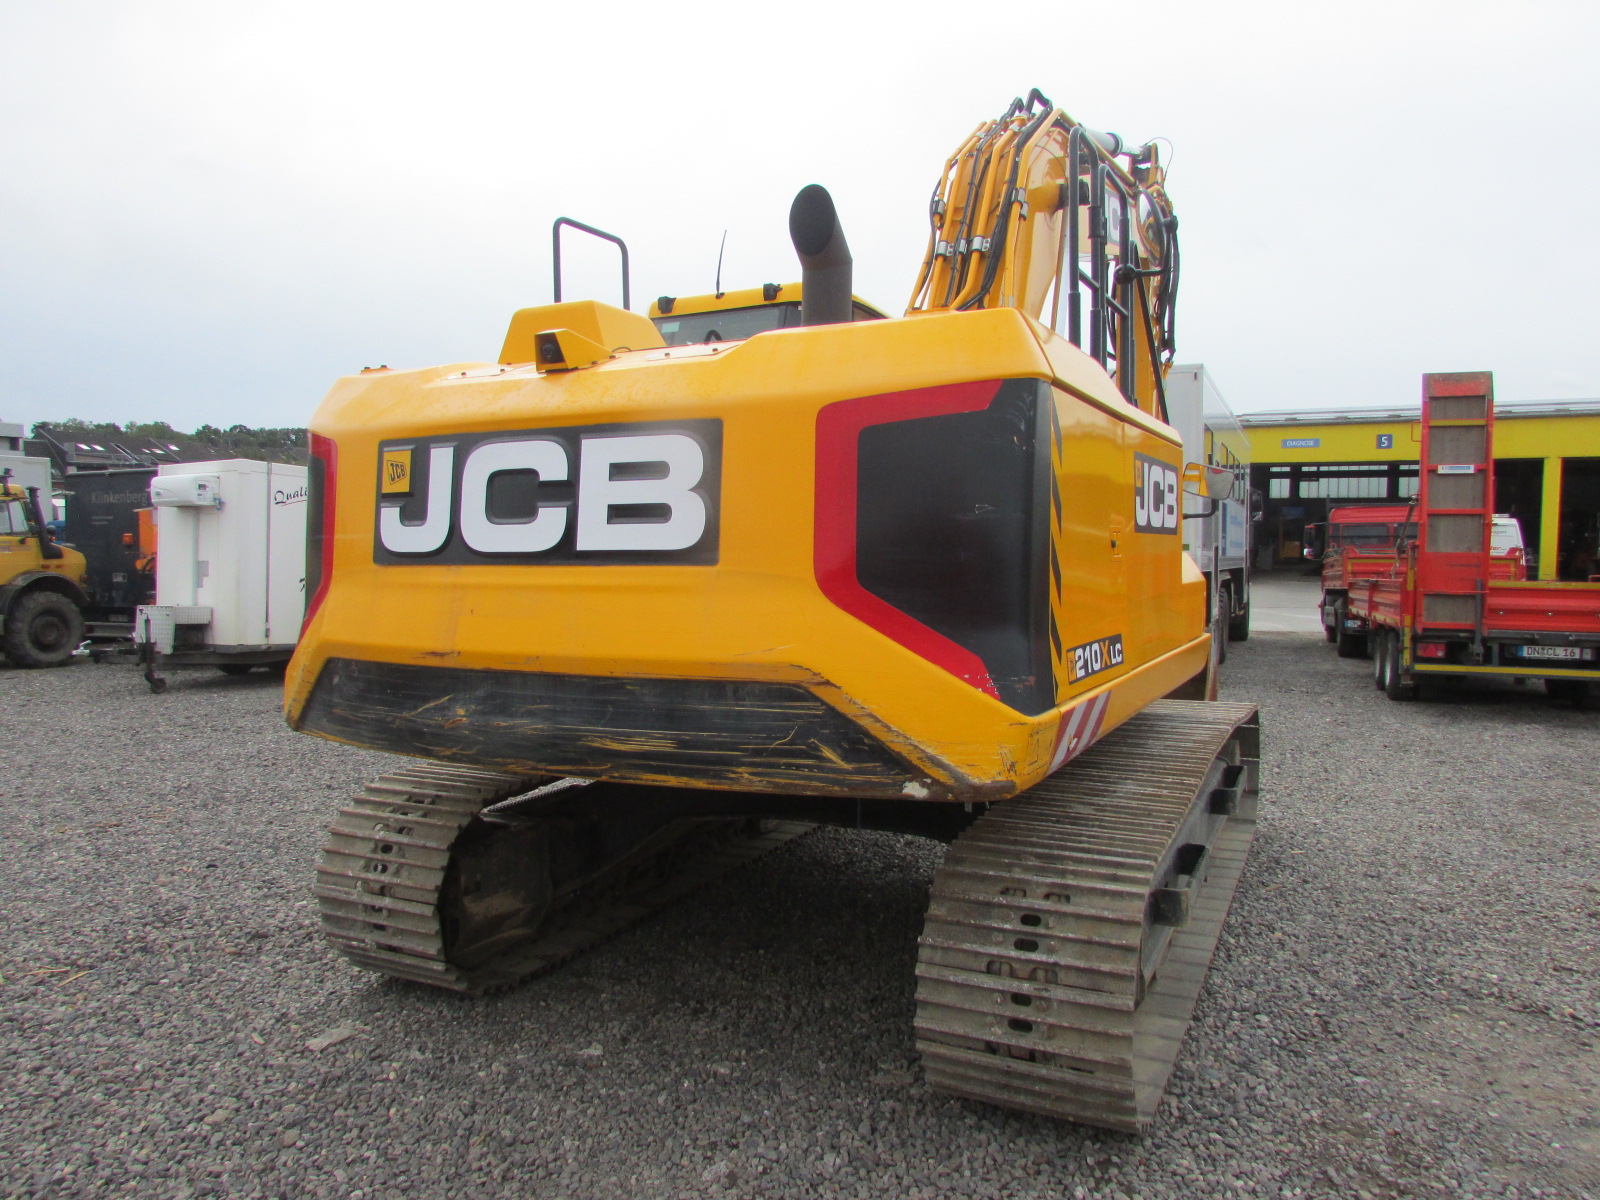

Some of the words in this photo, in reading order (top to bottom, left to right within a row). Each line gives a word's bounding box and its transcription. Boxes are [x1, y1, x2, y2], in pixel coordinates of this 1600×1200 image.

[1286, 439, 1315, 447] DIAGNOSE
[1380, 436, 1389, 447] 5
[390, 462, 406, 482] JCB
[91, 490, 148, 506] Klinkenberg
[379, 434, 706, 553] JCB
[1135, 462, 1178, 529] JCB
[1526, 646, 1540, 656] DN
[1546, 647, 1560, 657] CL
[1562, 648, 1576, 657] 16
